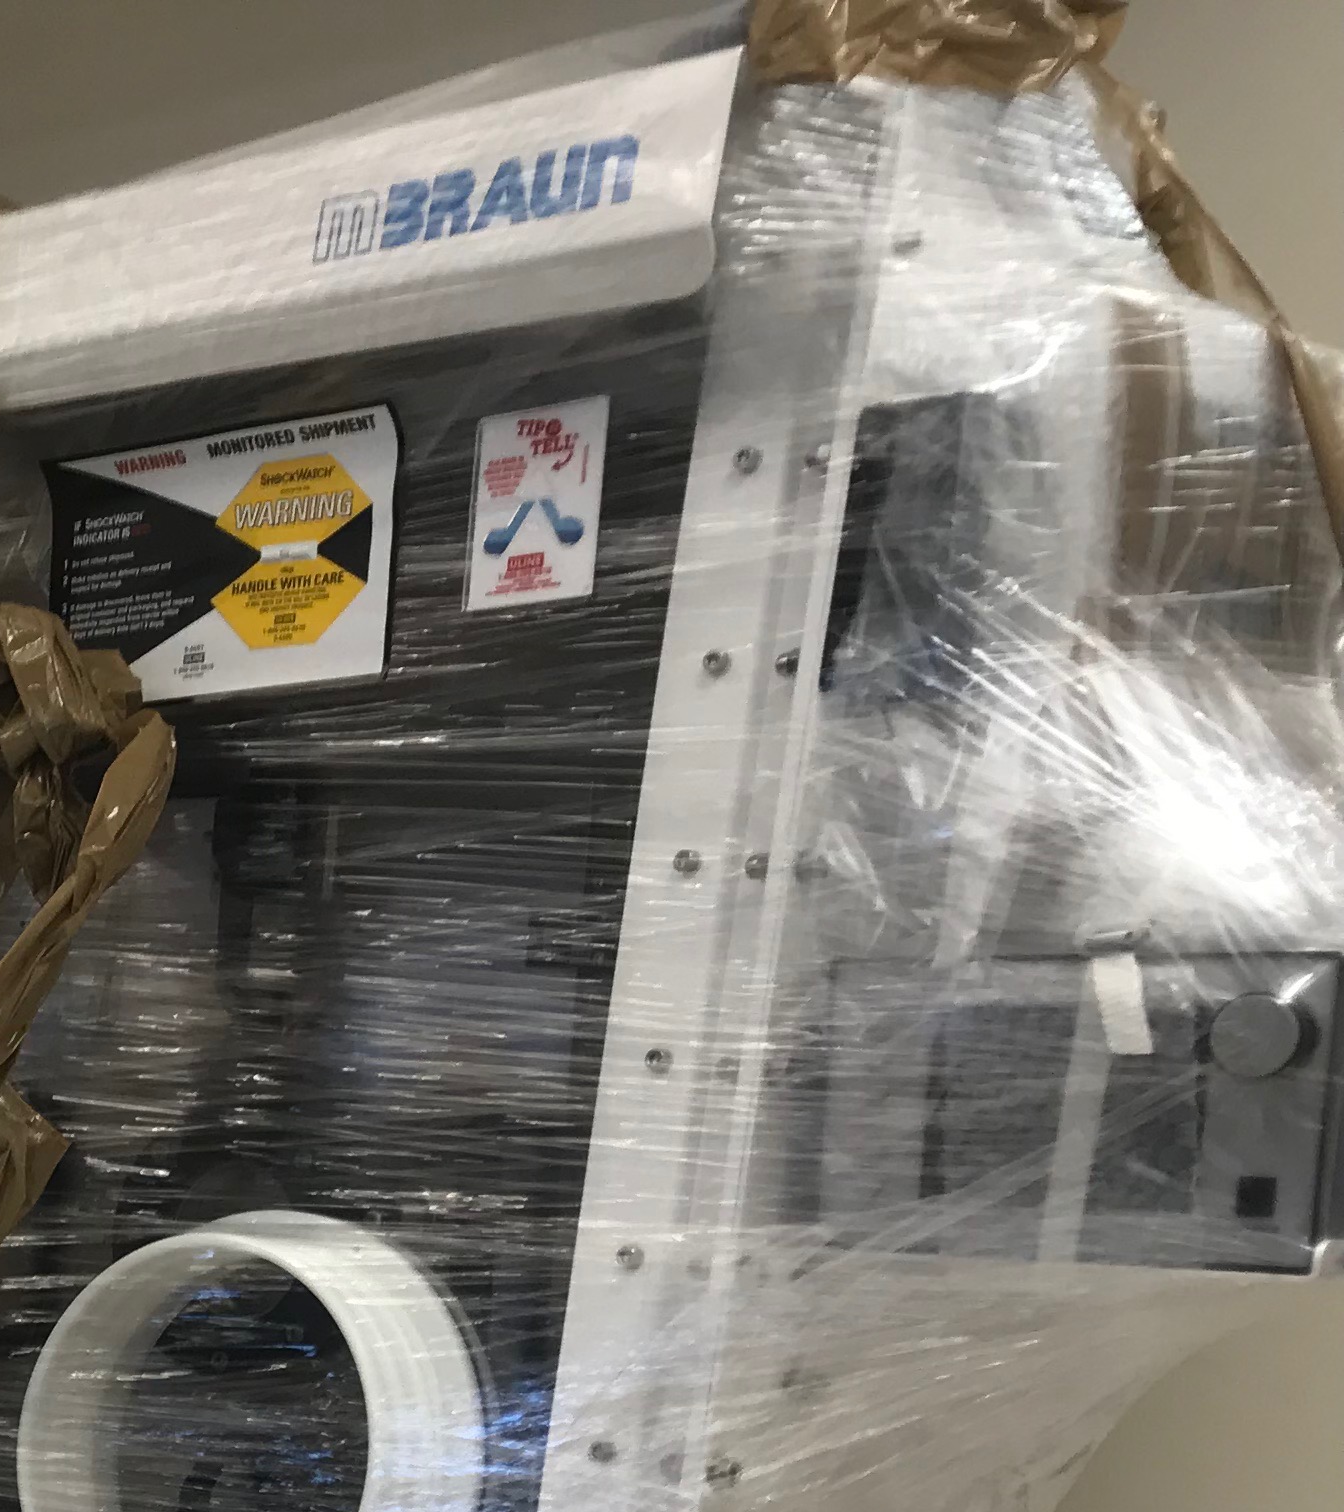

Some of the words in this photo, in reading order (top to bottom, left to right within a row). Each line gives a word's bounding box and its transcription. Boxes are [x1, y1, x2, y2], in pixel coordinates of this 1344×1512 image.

[114, 449, 187, 475] WARNING
[206, 428, 295, 459] MONITORED
[298, 412, 377, 442] SHIPMENT
[234, 488, 355, 531] WARNING
[73, 528, 120, 547] INDICATOR
[231, 578, 278, 597] HANDLE
[279, 575, 312, 590] WITH
[313, 571, 345, 586] CARE
